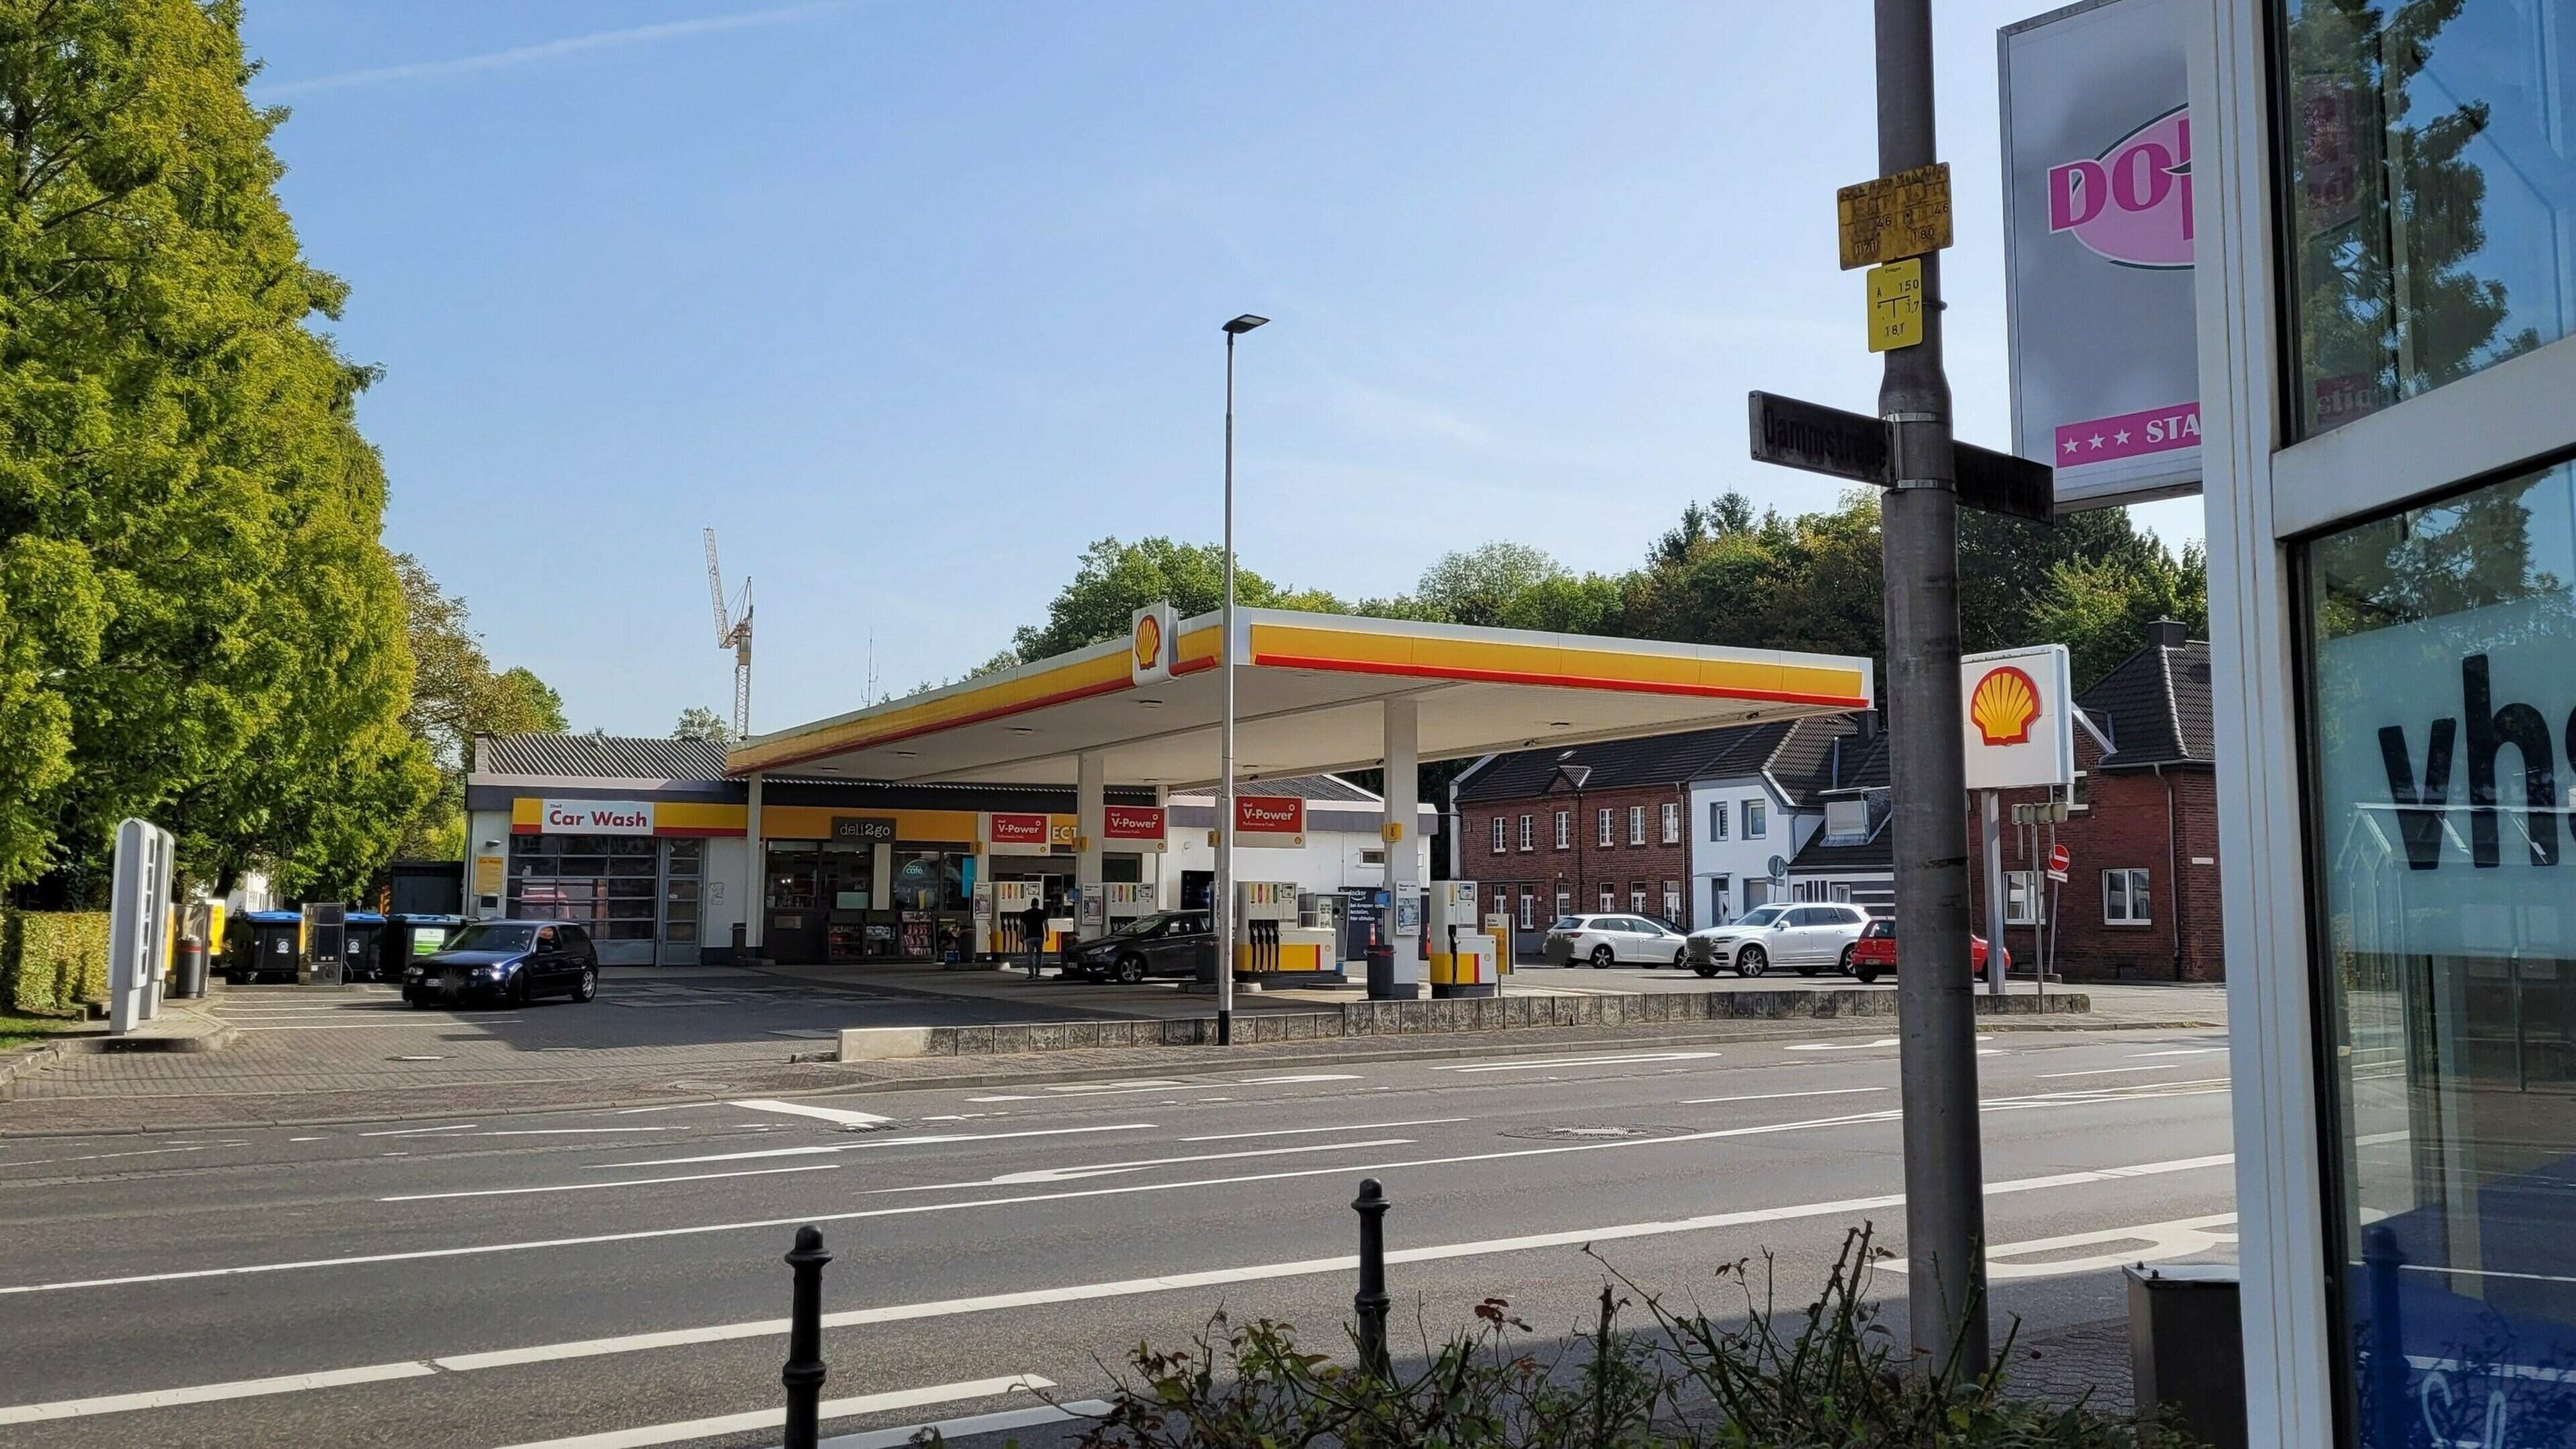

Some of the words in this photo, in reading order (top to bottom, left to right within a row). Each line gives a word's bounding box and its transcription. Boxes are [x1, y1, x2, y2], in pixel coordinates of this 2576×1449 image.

[2378, 654, 2576, 870] vh
[549, 810, 585, 826] Car
[591, 811, 647, 826] Wash
[1244, 808, 1293, 820] V-Power
[998, 824, 1039, 833] V-Power
[1111, 818, 1157, 828] V-Power
[840, 823, 891, 838] deli2go
[1052, 826, 1077, 839] ECT
